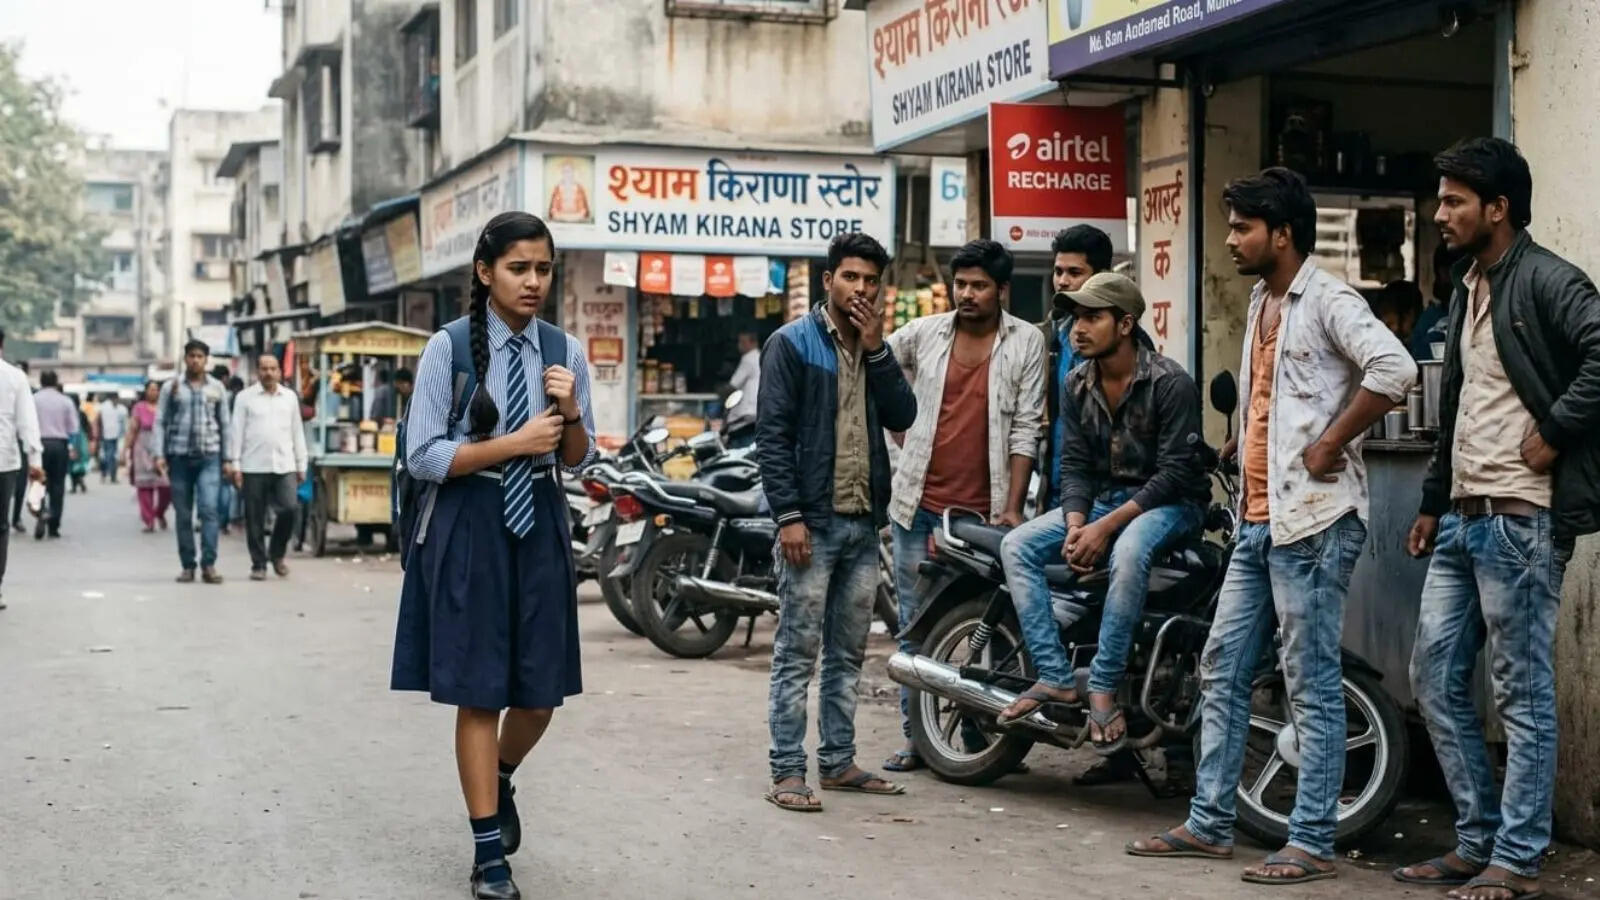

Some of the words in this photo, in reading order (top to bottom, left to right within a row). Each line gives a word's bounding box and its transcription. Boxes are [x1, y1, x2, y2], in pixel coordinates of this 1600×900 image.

[1173, 1, 1203, 25] Road,
[874, 8, 921, 80] श्याम
[892, 78, 932, 125] SHYAM
[936, 60, 984, 109] KIRANA
[987, 39, 1032, 88] STORE
[1037, 131, 1111, 163] airtel
[608, 165, 701, 203] श्याम
[707, 158, 810, 205] किराणा
[817, 163, 882, 209] स्टोर
[1008, 171, 1112, 191] RECHARGE
[608, 210, 687, 235] SHYAM
[696, 214, 782, 238] KIRANA
[791, 218, 863, 240] STORE
